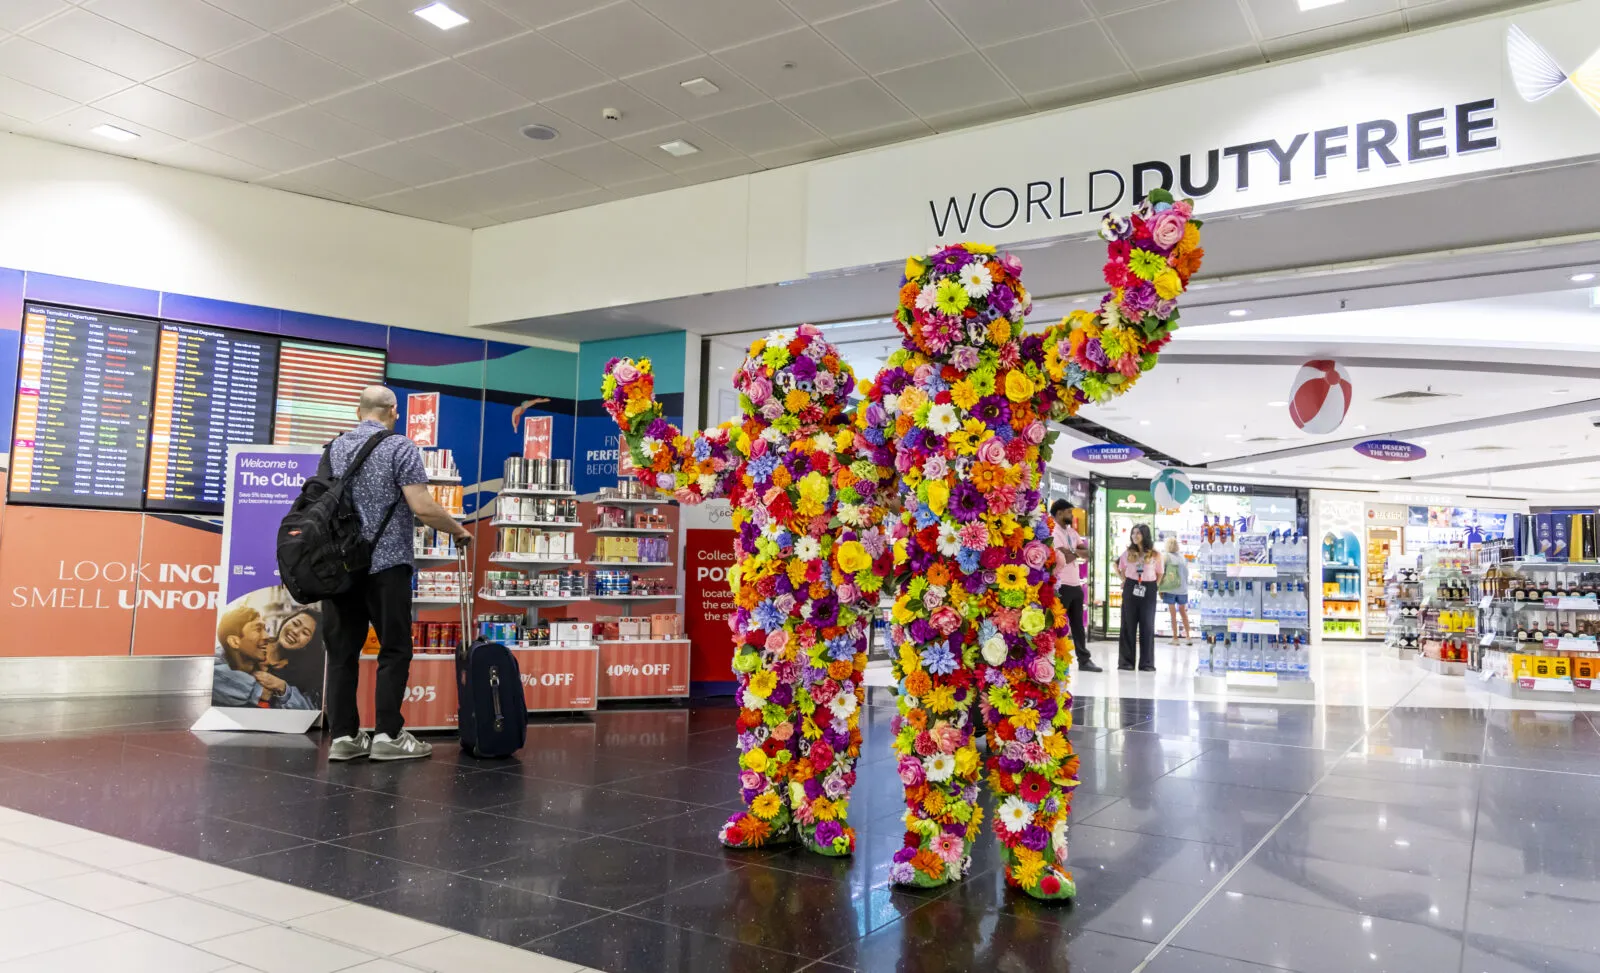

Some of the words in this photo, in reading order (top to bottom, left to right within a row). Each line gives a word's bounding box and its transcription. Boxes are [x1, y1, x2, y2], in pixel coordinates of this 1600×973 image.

[46, 309, 69, 317] Terminal
[69, 312, 98, 321] Departures
[178, 326, 199, 334] Terminal
[199, 329, 225, 337] Departures
[1382, 443, 1412, 452] DESERVE
[1370, 449, 1384, 457] THE
[1384, 450, 1410, 458] WORLD
[240, 458, 286, 469] Welcome
[288, 460, 298, 469] to
[240, 472, 269, 486] The
[271, 472, 306, 487] Club
[59, 560, 151, 582] LOOK
[11, 586, 110, 608] SMELL
[702, 601, 719, 609] the
[704, 612, 720, 621] the
[606, 664, 639, 677] 40%
[641, 663, 671, 676] OFF
[541, 673, 575, 686] OFF
